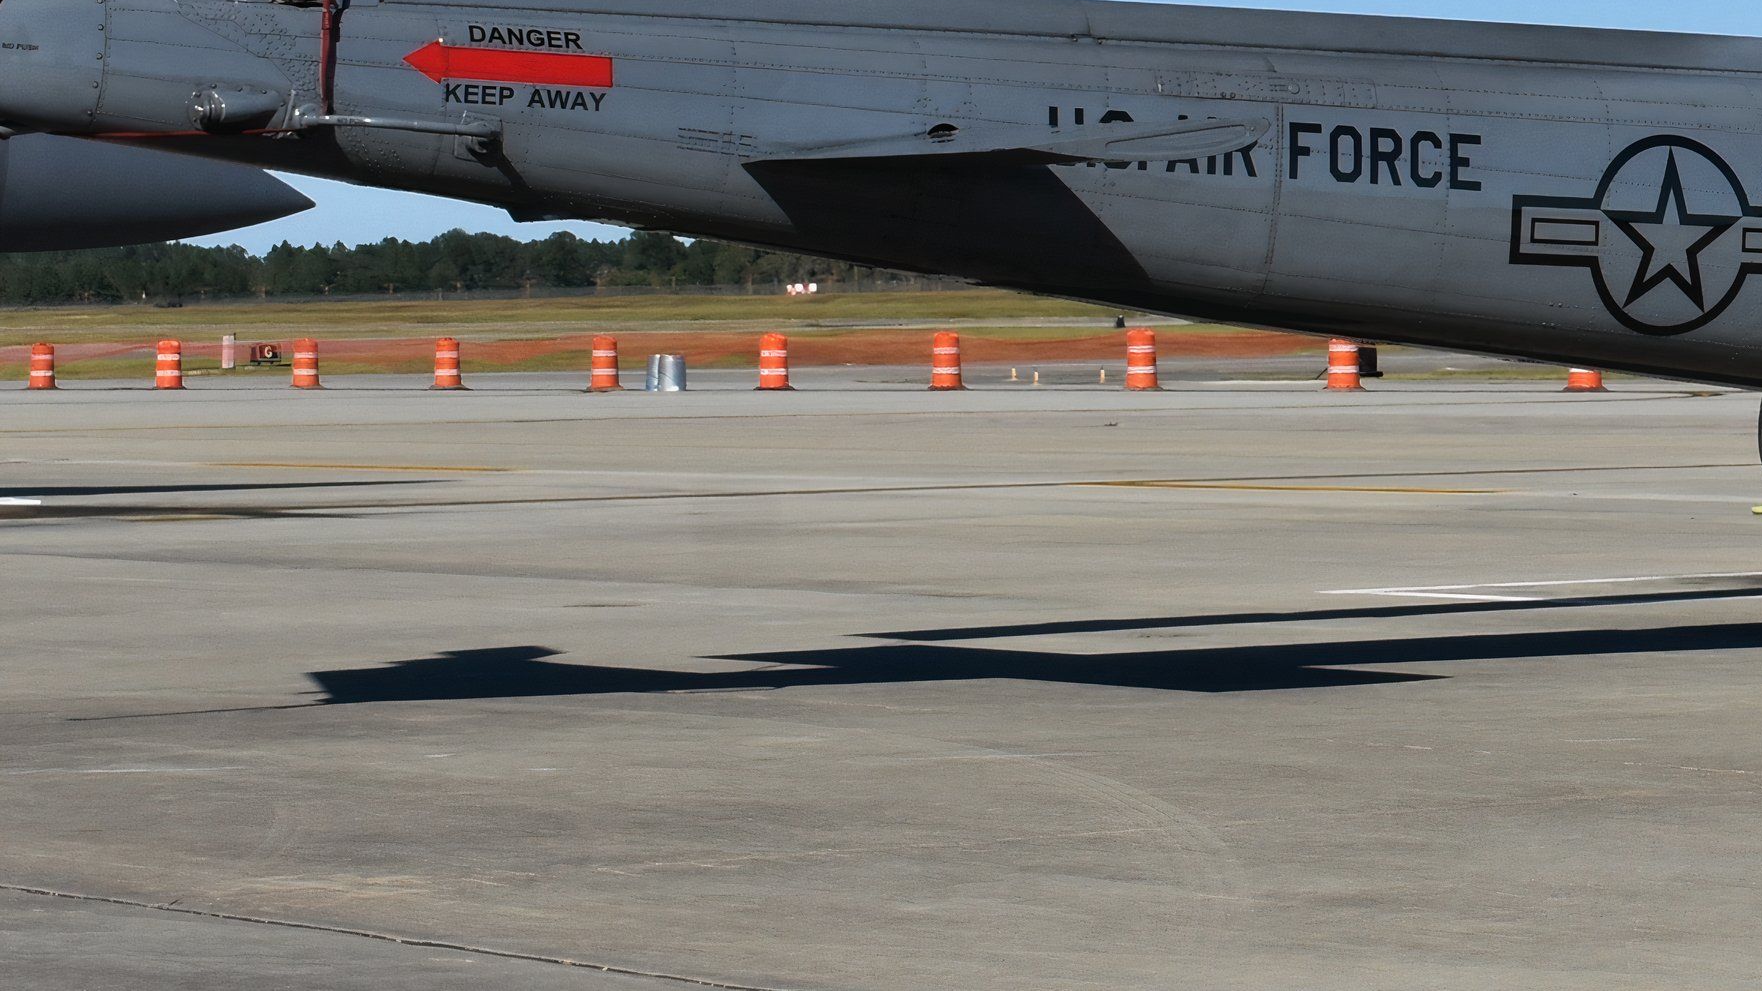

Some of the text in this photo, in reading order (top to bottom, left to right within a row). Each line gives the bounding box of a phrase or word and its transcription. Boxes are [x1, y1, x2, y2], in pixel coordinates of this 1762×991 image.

[468, 24, 583, 50] DANGER
[445, 83, 607, 112] KEEP AWAY
[1288, 121, 1482, 192] FORCE
